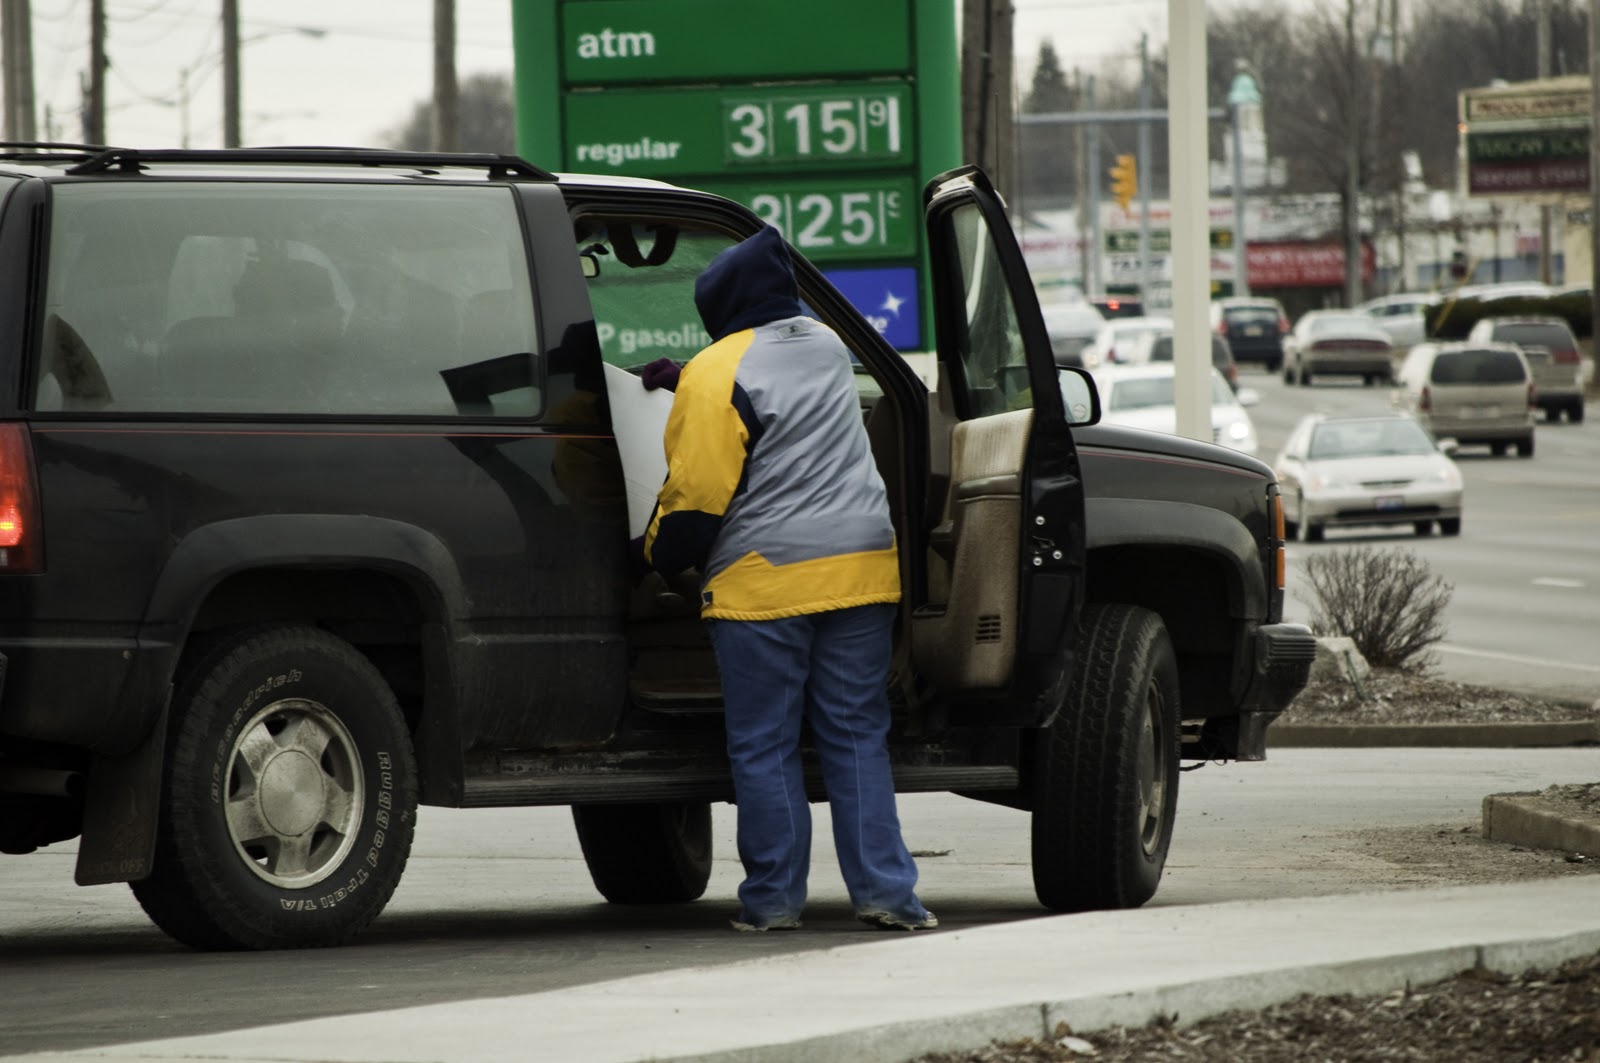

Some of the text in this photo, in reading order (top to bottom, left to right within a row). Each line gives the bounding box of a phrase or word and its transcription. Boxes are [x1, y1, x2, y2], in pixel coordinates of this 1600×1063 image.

[578, 27, 656, 58] atm
[577, 137, 681, 166] regular
[280, 751, 393, 911] Rugged Trail T/A
